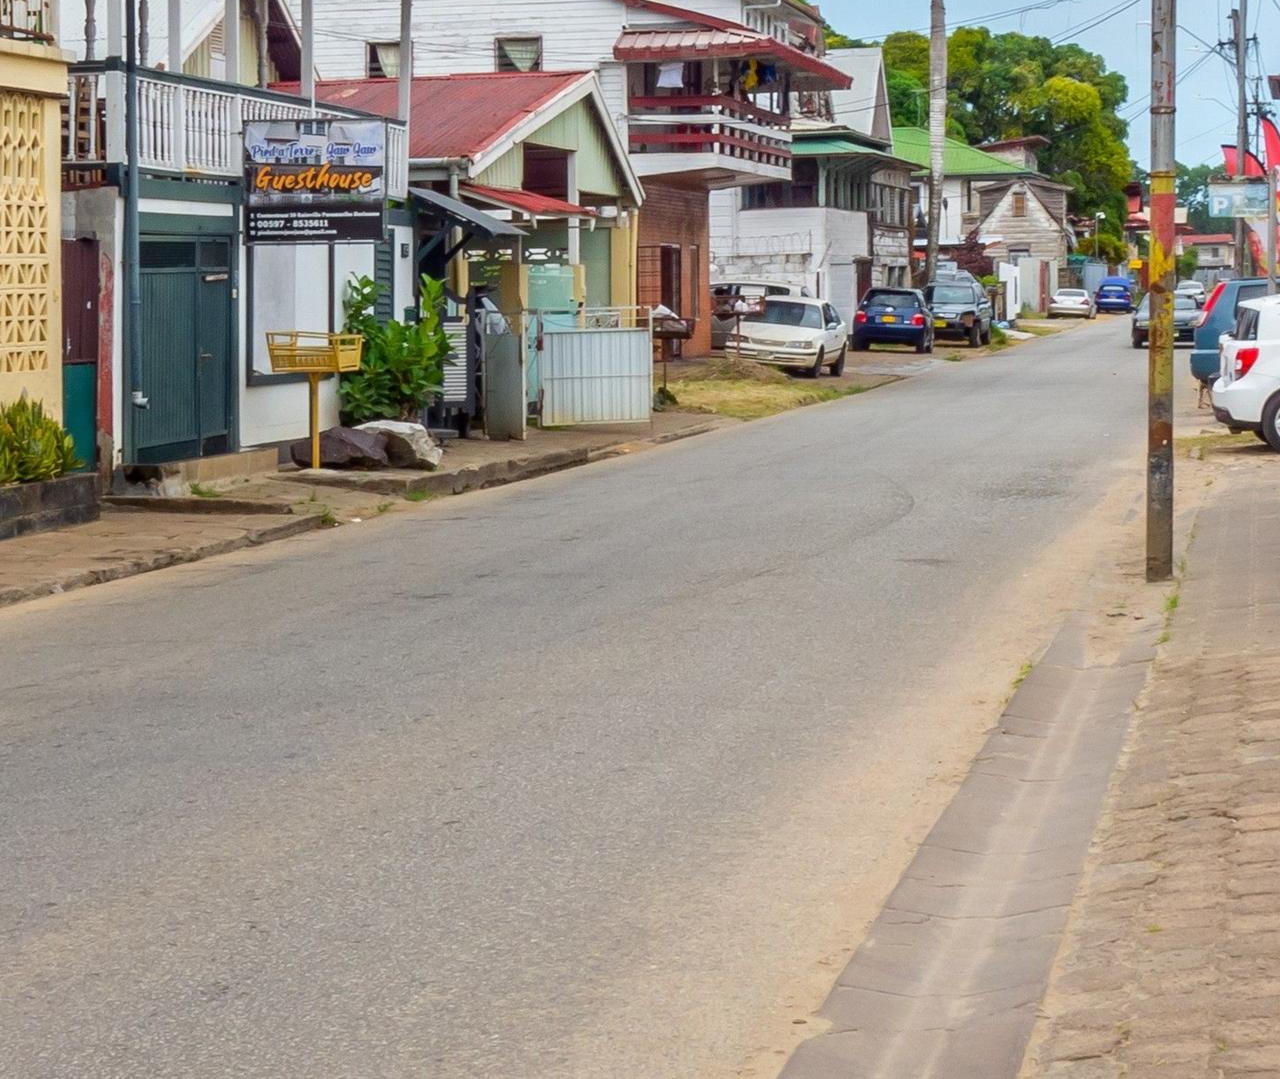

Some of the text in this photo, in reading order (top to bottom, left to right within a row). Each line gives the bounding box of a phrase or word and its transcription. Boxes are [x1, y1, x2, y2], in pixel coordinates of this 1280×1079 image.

[256, 161, 373, 190] Guesthouse
[1212, 197, 1228, 215] P
[256, 219, 285, 229] 00597
